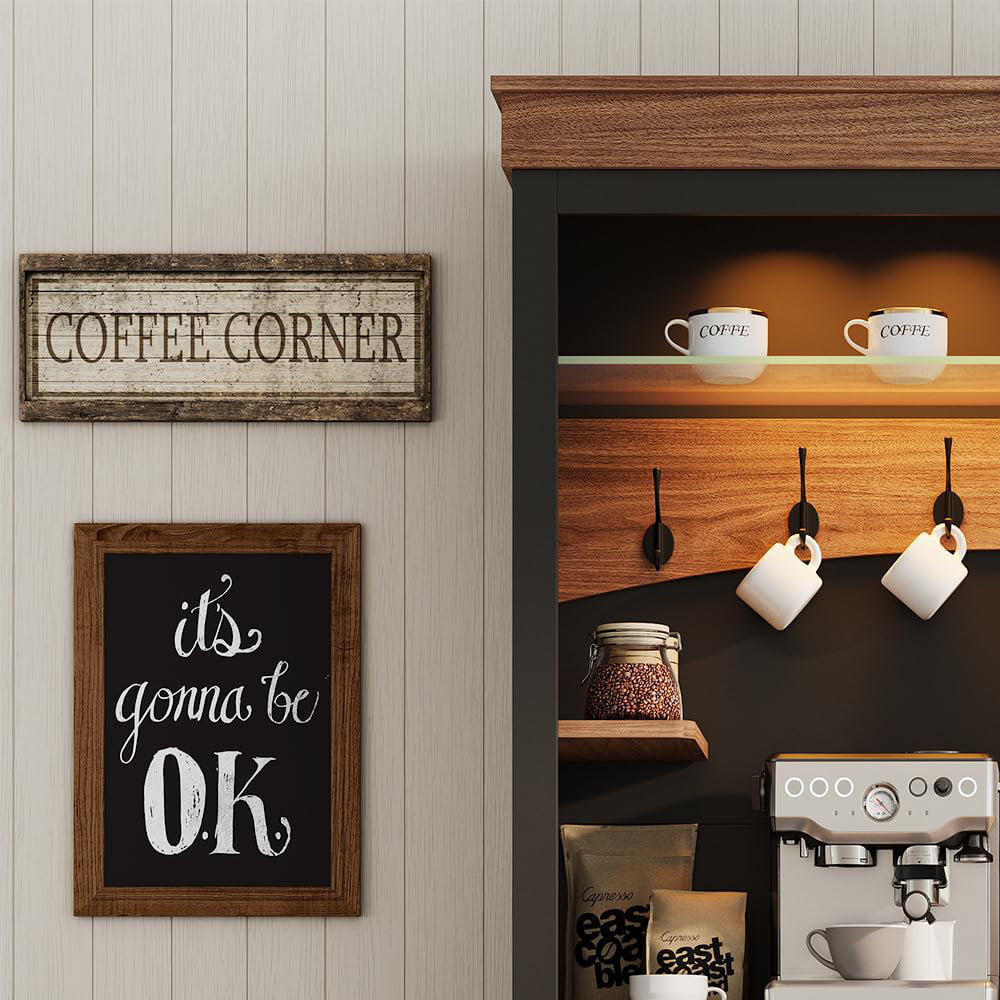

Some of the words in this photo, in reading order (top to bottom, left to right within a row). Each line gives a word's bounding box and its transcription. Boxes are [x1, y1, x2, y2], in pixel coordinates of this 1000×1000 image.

[45, 312, 210, 363] COFFEE
[224, 312, 407, 363] CORNER
[699, 324, 750, 338] COFFE
[880, 324, 931, 338] COFFE
[174, 574, 262, 657] it's
[115, 681, 252, 764] gonna
[261, 660, 320, 724] be
[581, 887, 634, 906] Capresso
[575, 903, 651, 941] eas
[660, 931, 701, 944] Capresso
[656, 937, 723, 968] east
